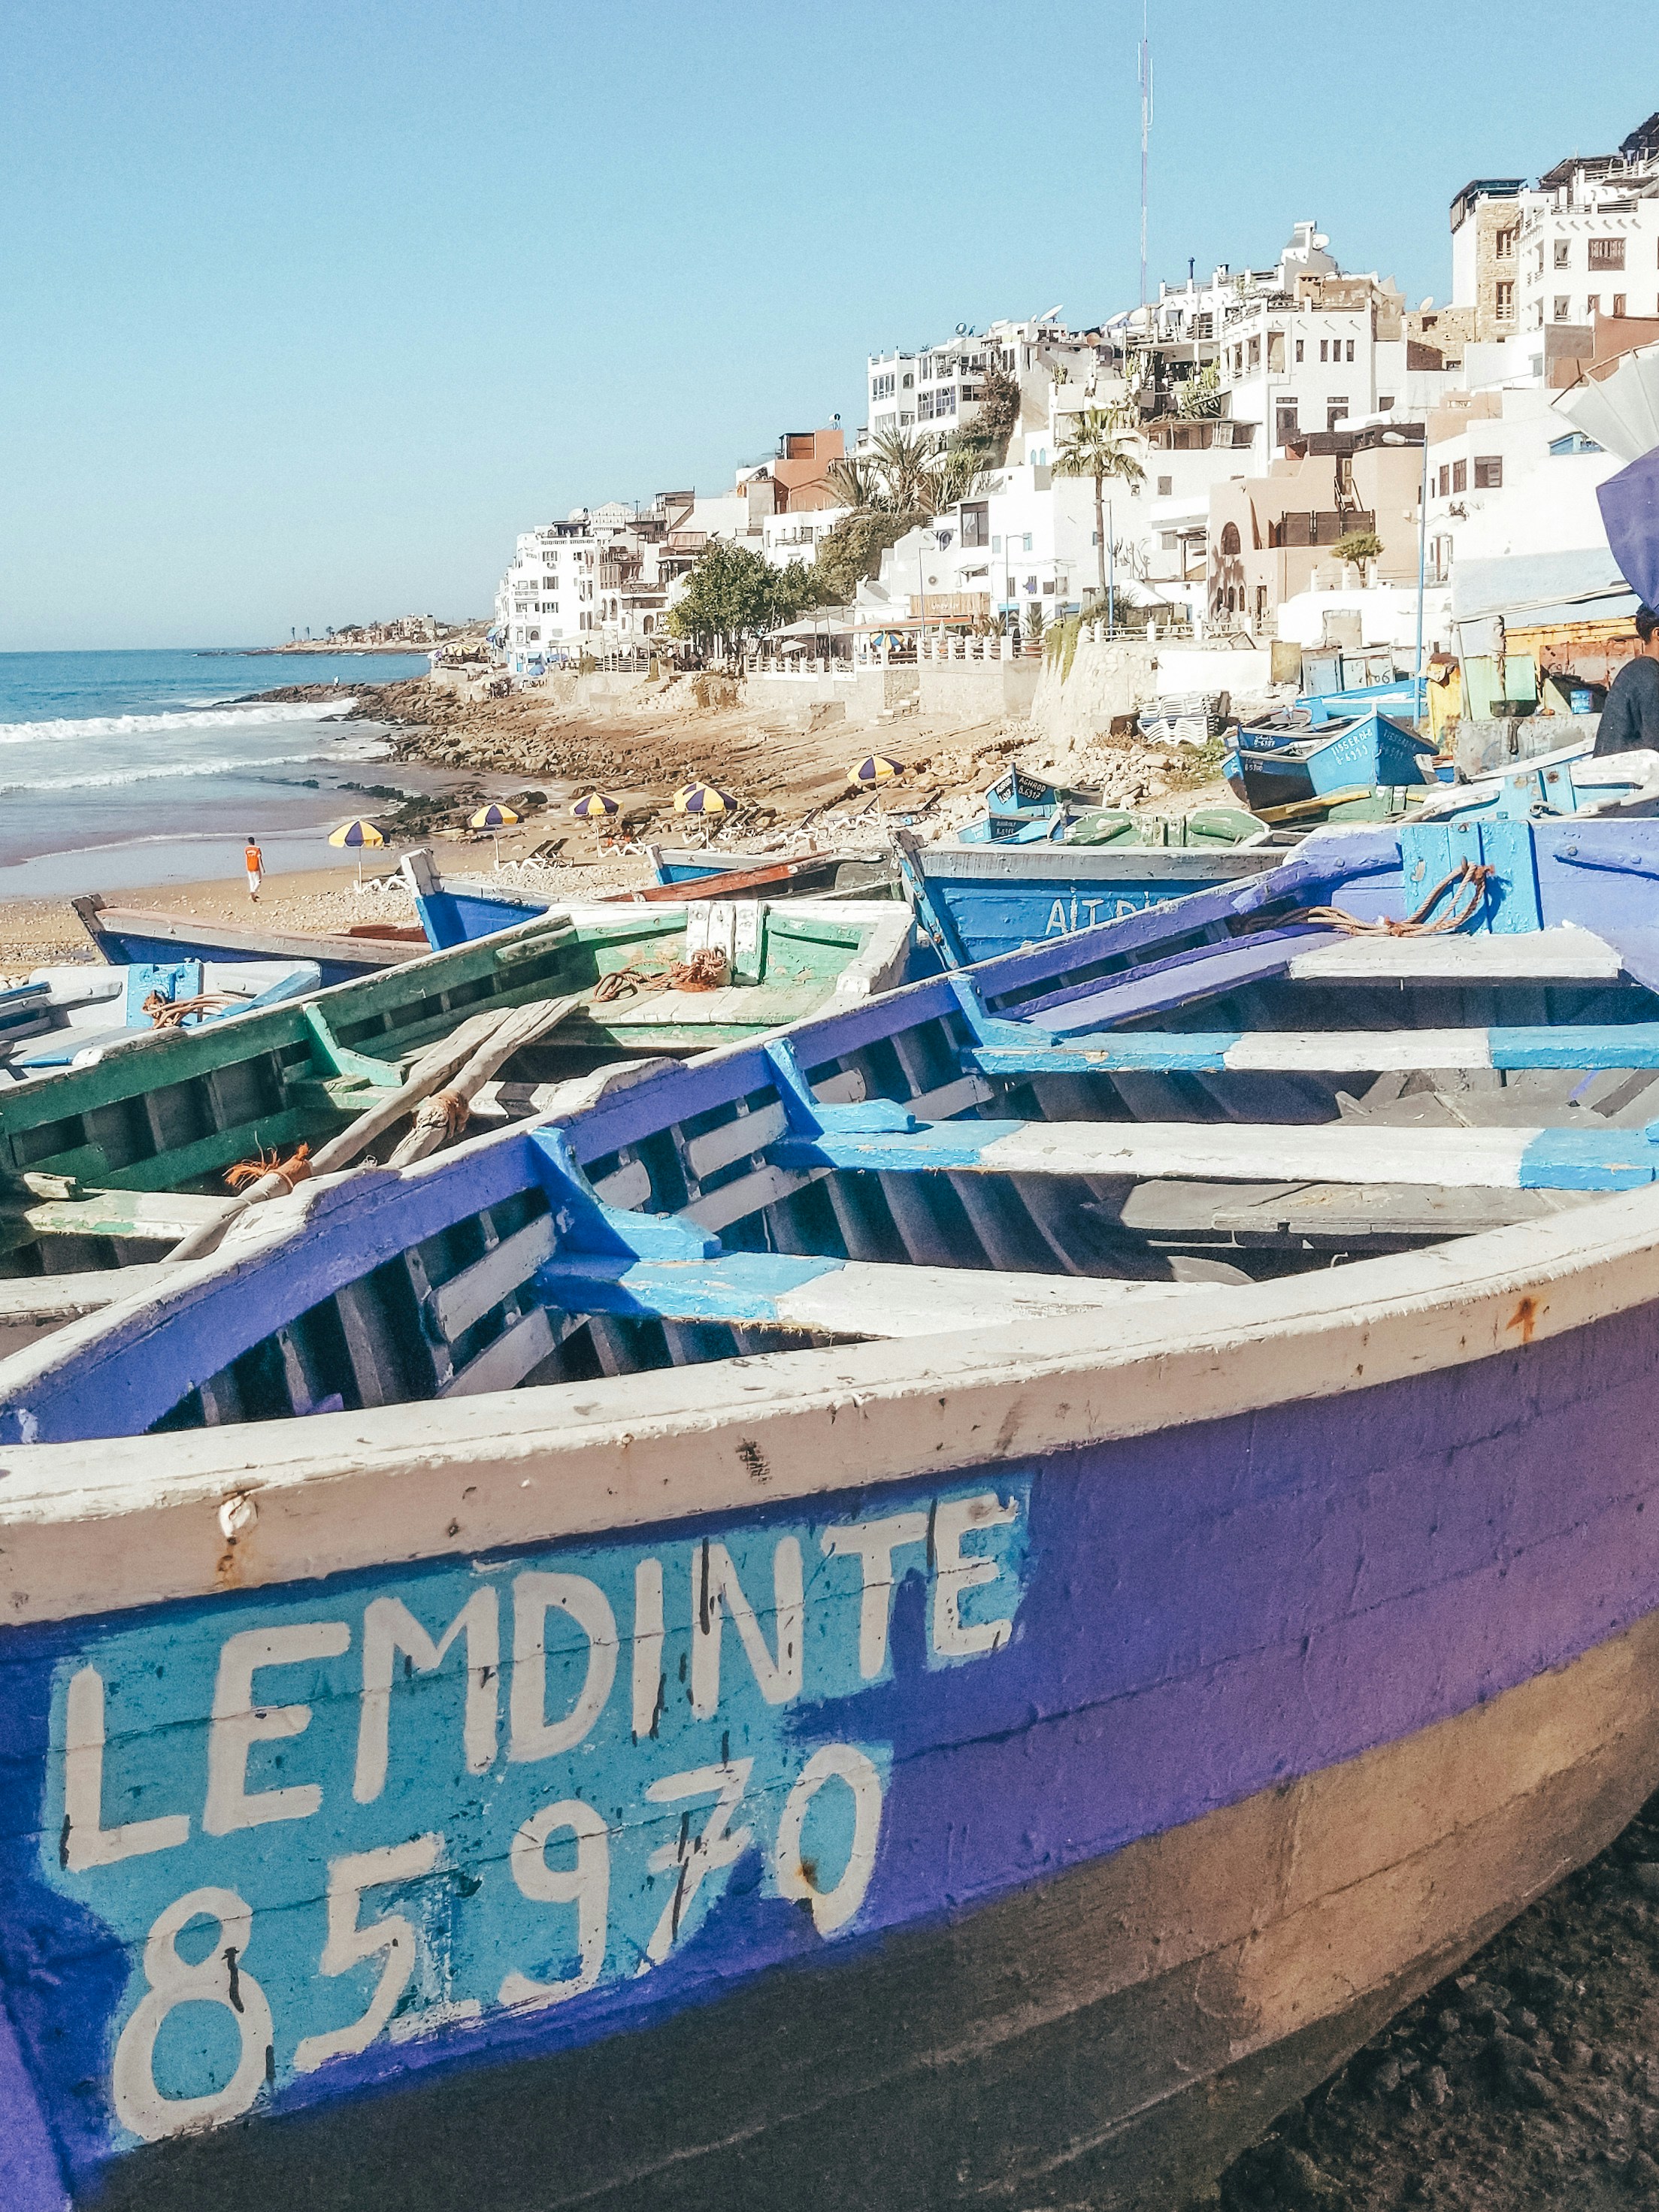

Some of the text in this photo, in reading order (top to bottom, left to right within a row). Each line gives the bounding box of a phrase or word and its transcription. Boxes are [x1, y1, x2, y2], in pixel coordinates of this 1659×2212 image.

[1019, 776, 1046, 793] AGHROD
[62, 1493, 1019, 1872] LEMDINTE
[113, 1744, 882, 2141] 85970
